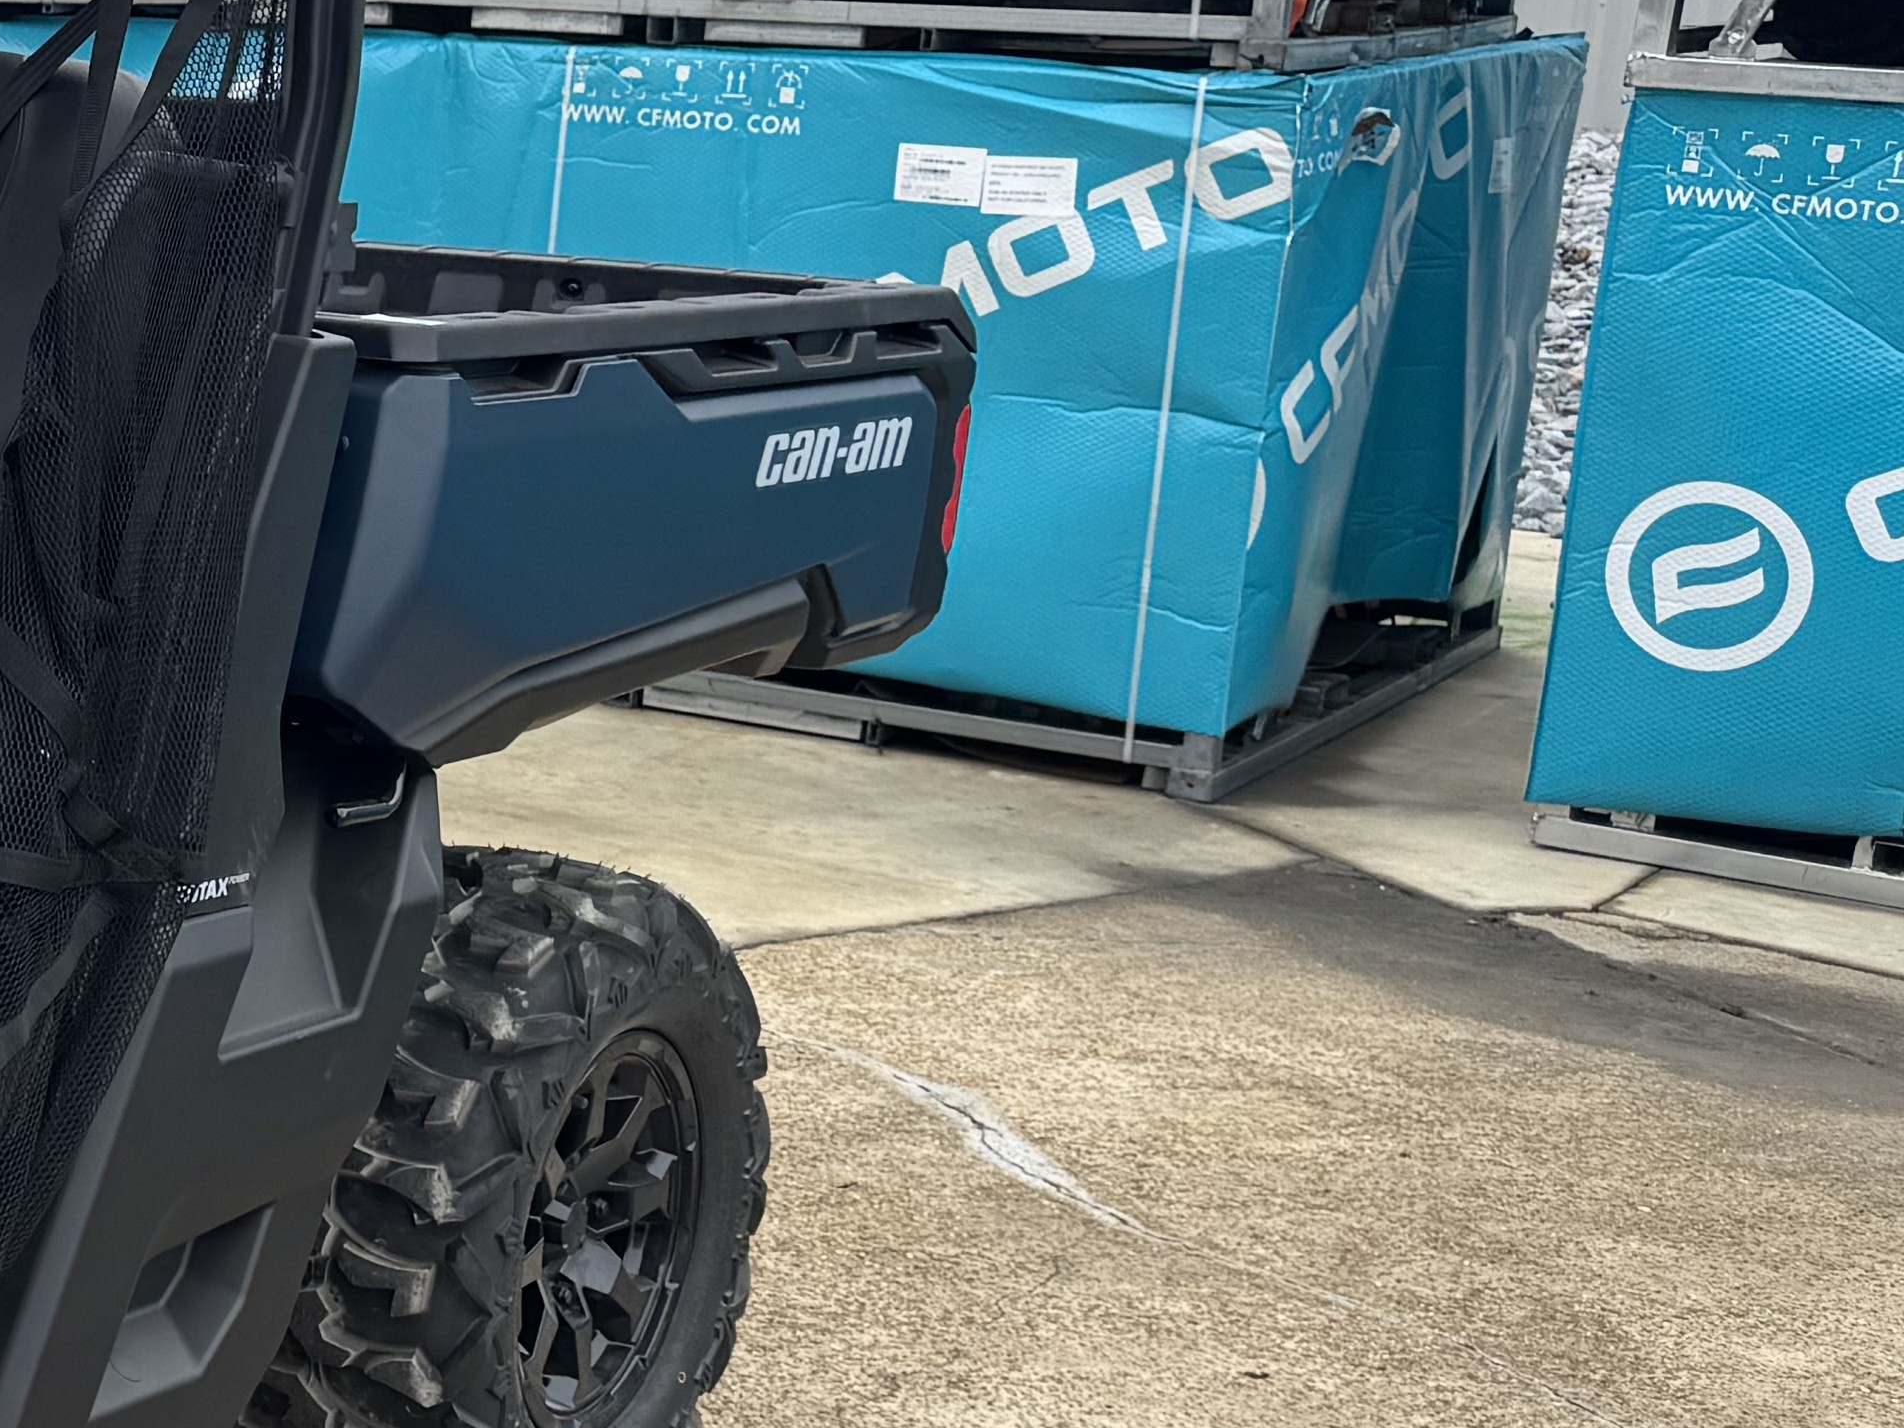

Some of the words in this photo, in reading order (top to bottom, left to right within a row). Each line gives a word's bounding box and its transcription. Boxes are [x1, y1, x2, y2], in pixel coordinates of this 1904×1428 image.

[565, 103, 630, 125] WWW.
[637, 108, 739, 133] CFMOTO.
[746, 114, 801, 136] COM
[1665, 184, 1759, 212] WWW.
[755, 416, 913, 488] can-am
